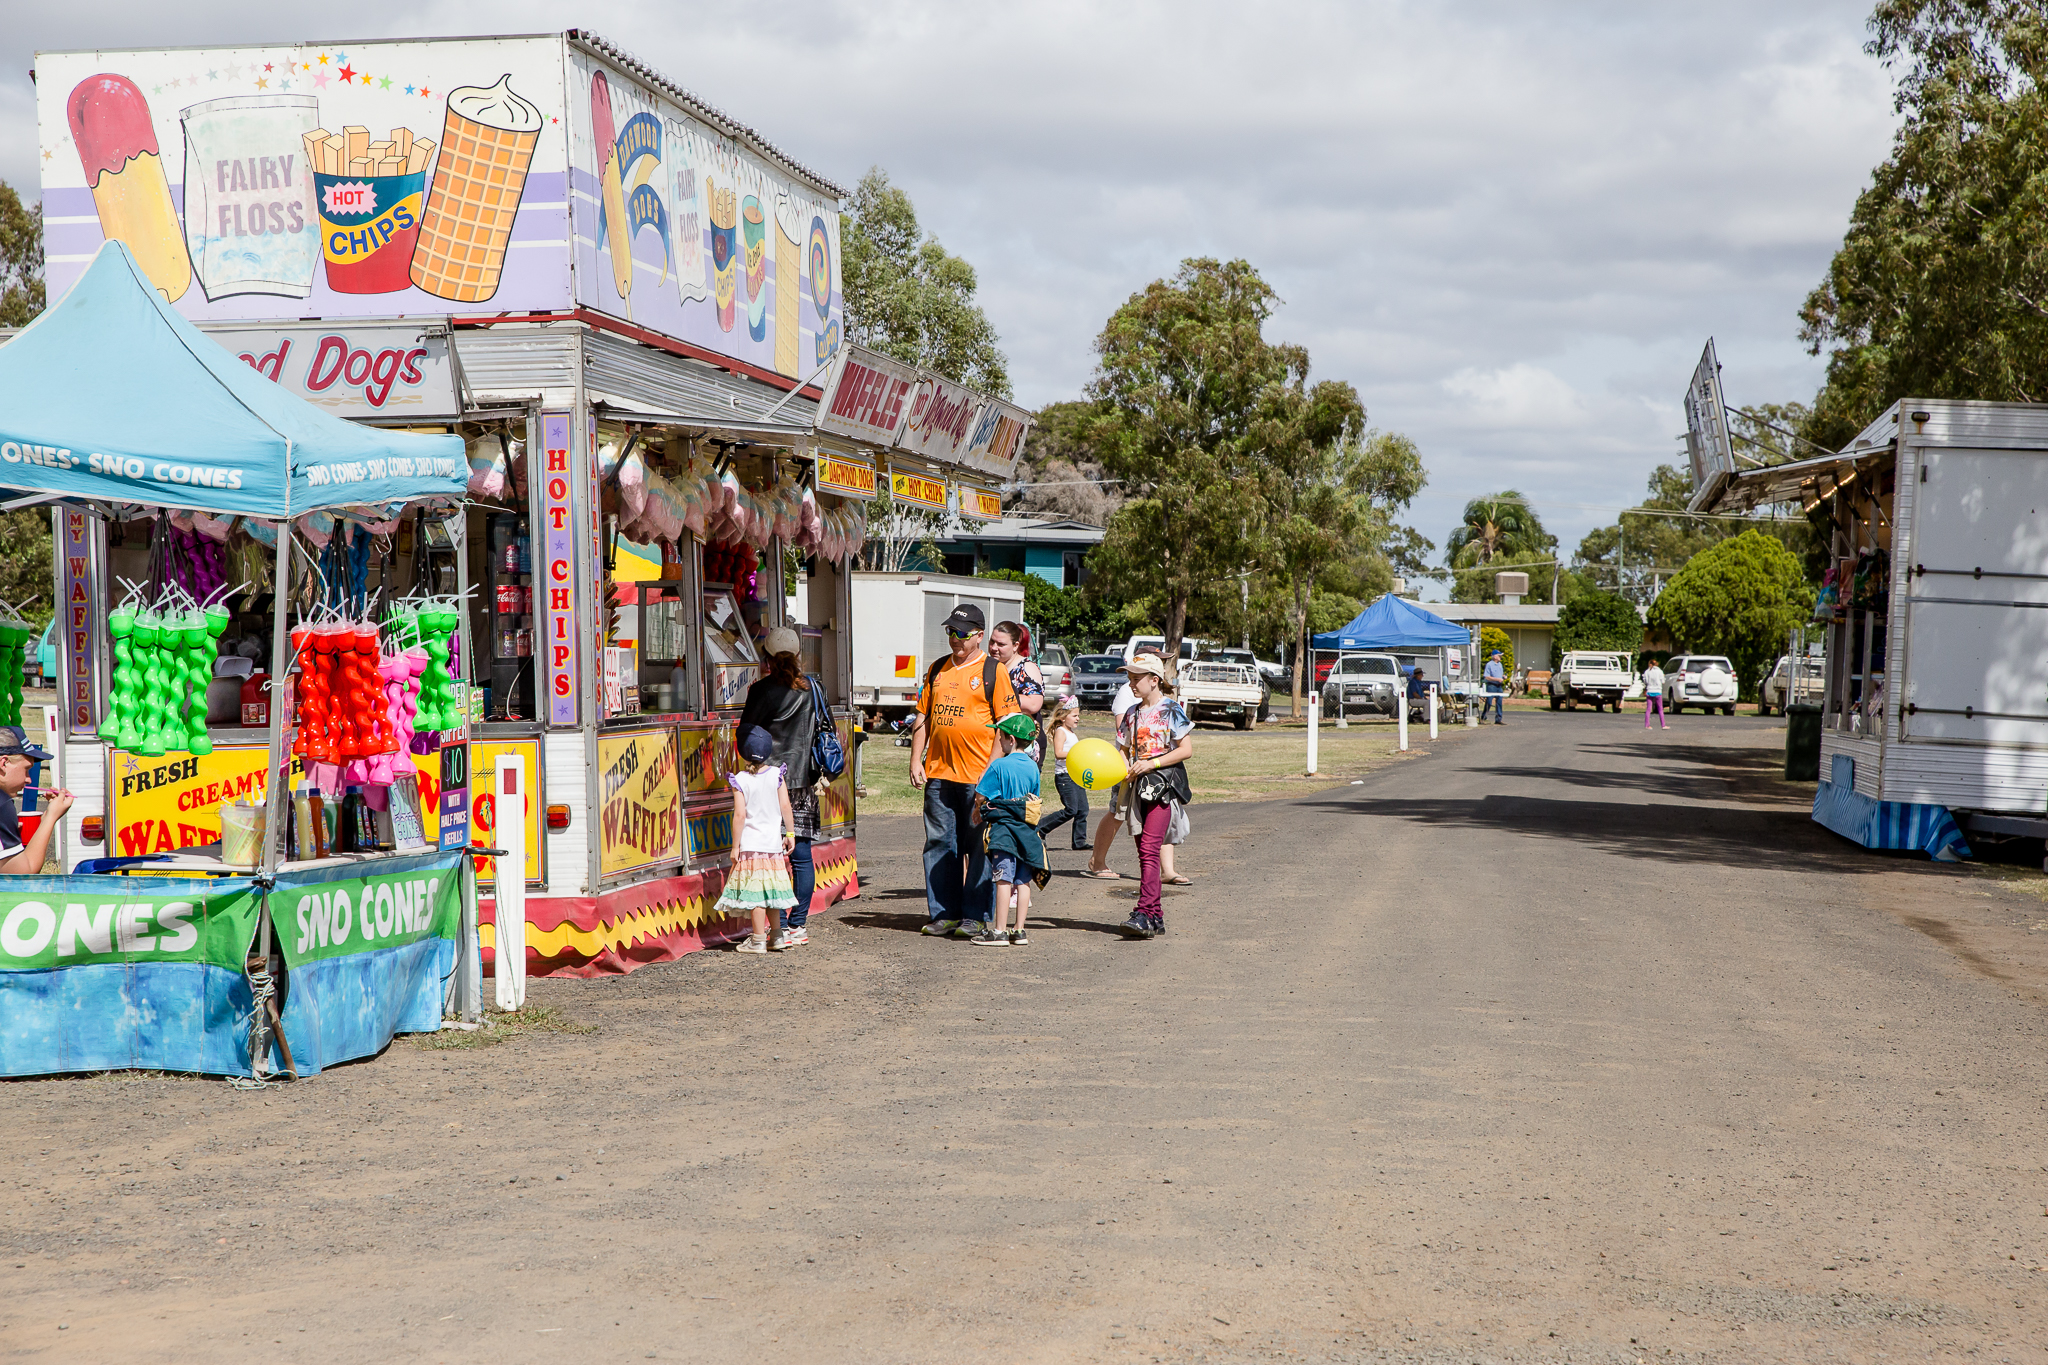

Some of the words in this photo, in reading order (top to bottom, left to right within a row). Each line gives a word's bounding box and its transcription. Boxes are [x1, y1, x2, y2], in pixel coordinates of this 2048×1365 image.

[619, 121, 659, 166] DAGWOOD
[216, 154, 294, 193] FAIRY
[677, 168, 695, 201] FAIRY
[333, 191, 364, 206] HOT
[633, 193, 659, 225] DOGS
[218, 200, 304, 238] FLOSS
[329, 205, 415, 256] CHIPS
[679, 211, 700, 243] FLOSS
[716, 267, 734, 298] CHIPS
[307, 336, 428, 408] Dogs
[830, 360, 910, 432] WAFFLES
[987, 414, 1025, 461] DRINKS
[0, 441, 72, 470] ONES
[88, 453, 145, 480] SNO
[153, 463, 243, 490] CONES
[306, 464, 331, 487] SNO
[330, 461, 365, 485] CONES
[367, 458, 387, 481] SNO
[388, 456, 414, 478] CONES
[415, 456, 433, 477] SNO
[433, 457, 456, 478] CONES
[828, 461, 857, 487] DAGWOOD
[858, 468, 874, 490] DOGS
[547, 449, 569, 531] HOT
[589, 432, 599, 557] FAIRY
[908, 477, 922, 498] HOT
[924, 481, 943, 503] CHIPS
[69, 513, 84, 543] MY
[68, 556, 91, 728] WAFFLES
[549, 559, 573, 699] CHIPS
[593, 579, 602, 704] FLOSS
[449, 682, 466, 709] PER
[933, 704, 966, 717] COFFEE
[943, 695, 956, 704] THE
[121, 757, 199, 797] FRESH
[177, 768, 269, 812] CREAMY
[443, 747, 463, 788] $10
[604, 739, 639, 804] FRESH
[642, 734, 675, 803] CREAMY
[390, 777, 419, 817] SNO
[447, 793, 461, 808] WITH
[823, 784, 849, 820] DOGS
[118, 818, 222, 858] WAFF
[395, 814, 424, 841] CONES
[441, 812, 453, 828] HALF
[453, 810, 467, 826] PRICE
[444, 829, 463, 846] REFILLS
[602, 792, 678, 859] WAFFLES
[687, 816, 710, 853] ICY
[712, 813, 734, 848] COL
[0, 900, 199, 959] ONES
[297, 888, 353, 955] SNO
[359, 877, 439, 942] CONES
